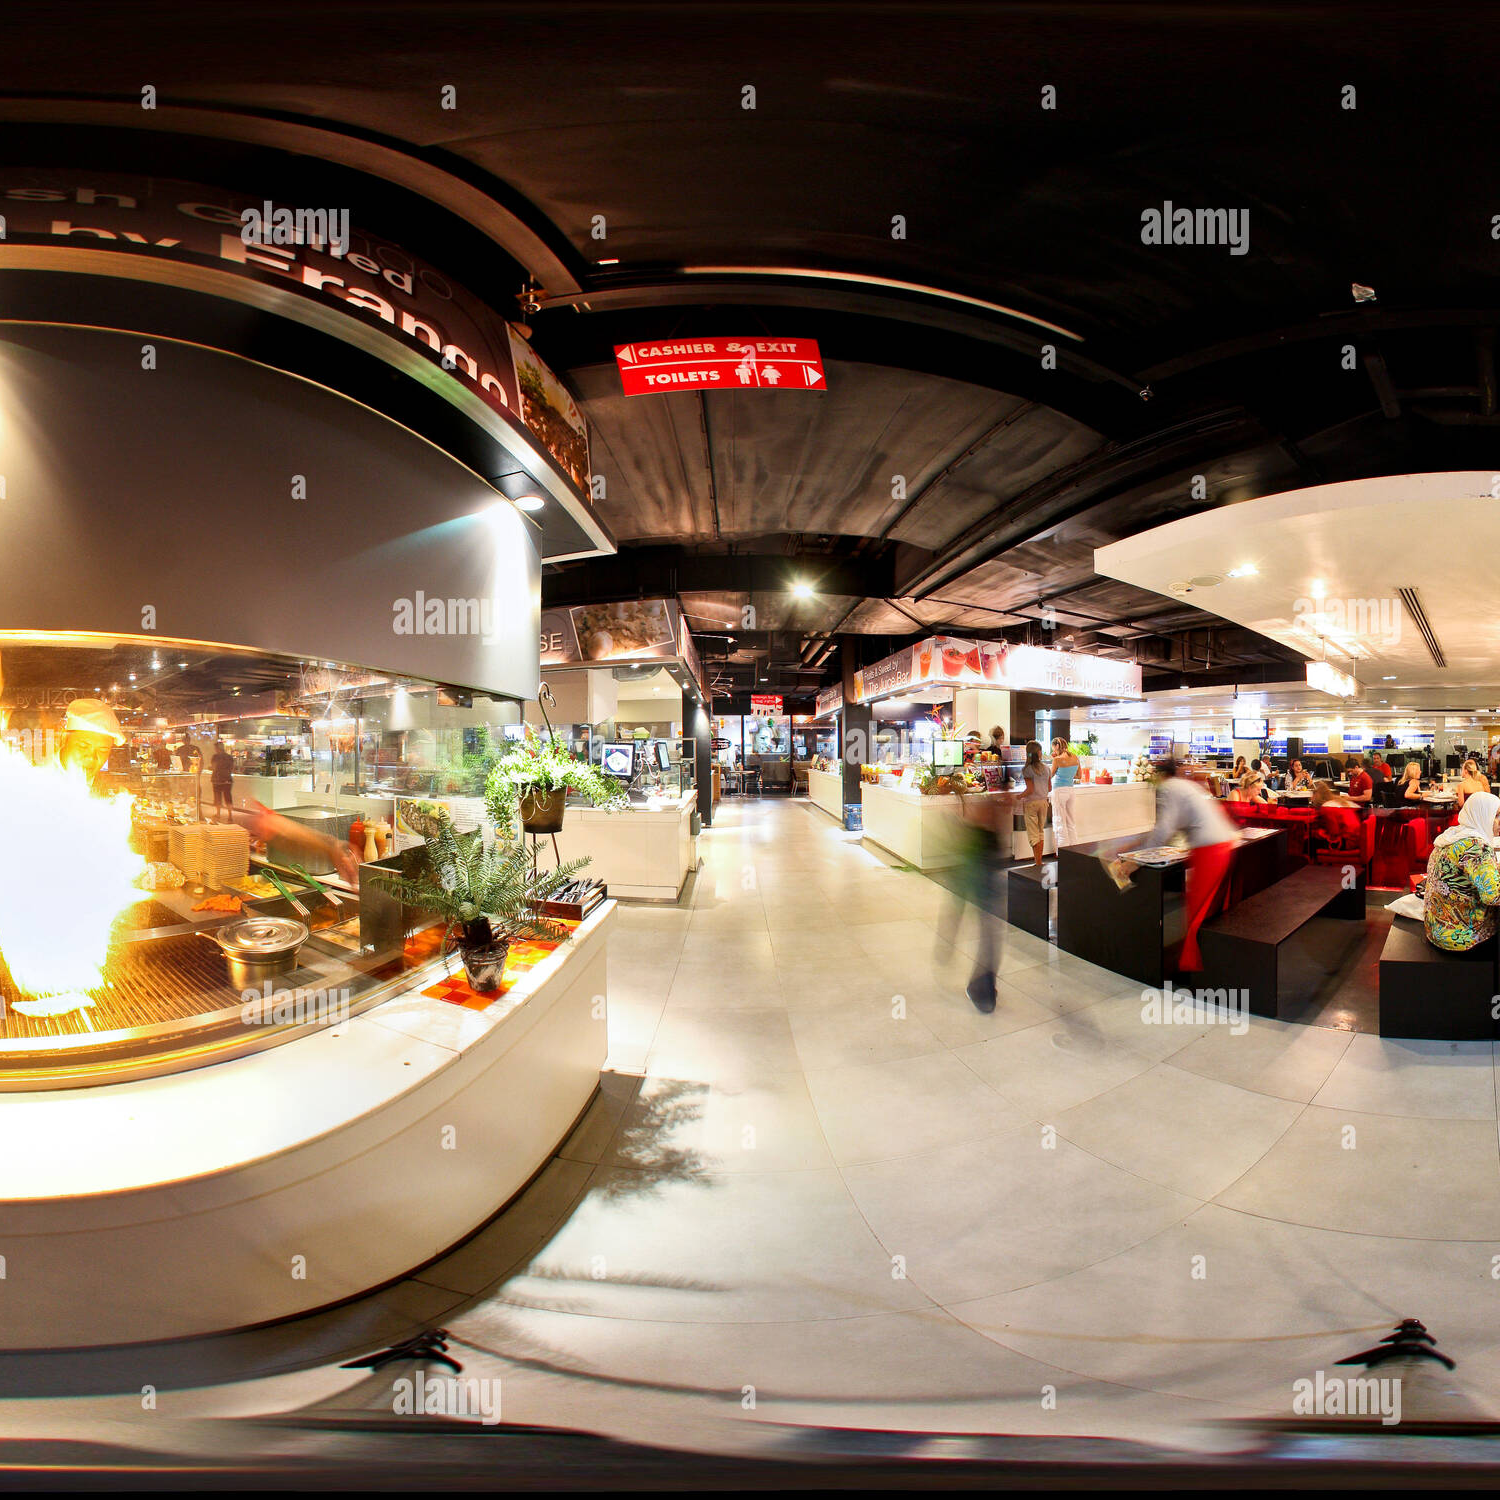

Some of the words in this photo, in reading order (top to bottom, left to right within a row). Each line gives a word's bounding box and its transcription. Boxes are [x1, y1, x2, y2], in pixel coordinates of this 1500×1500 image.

[638, 343, 716, 358] CASHIER
[726, 342, 748, 353] &
[756, 342, 797, 353] EXIT
[645, 370, 721, 386] TOILETS
[868, 681, 879, 695] The
[897, 671, 910, 685] Bar
[1046, 671, 1073, 689] The
[1115, 679, 1137, 695] Bar
